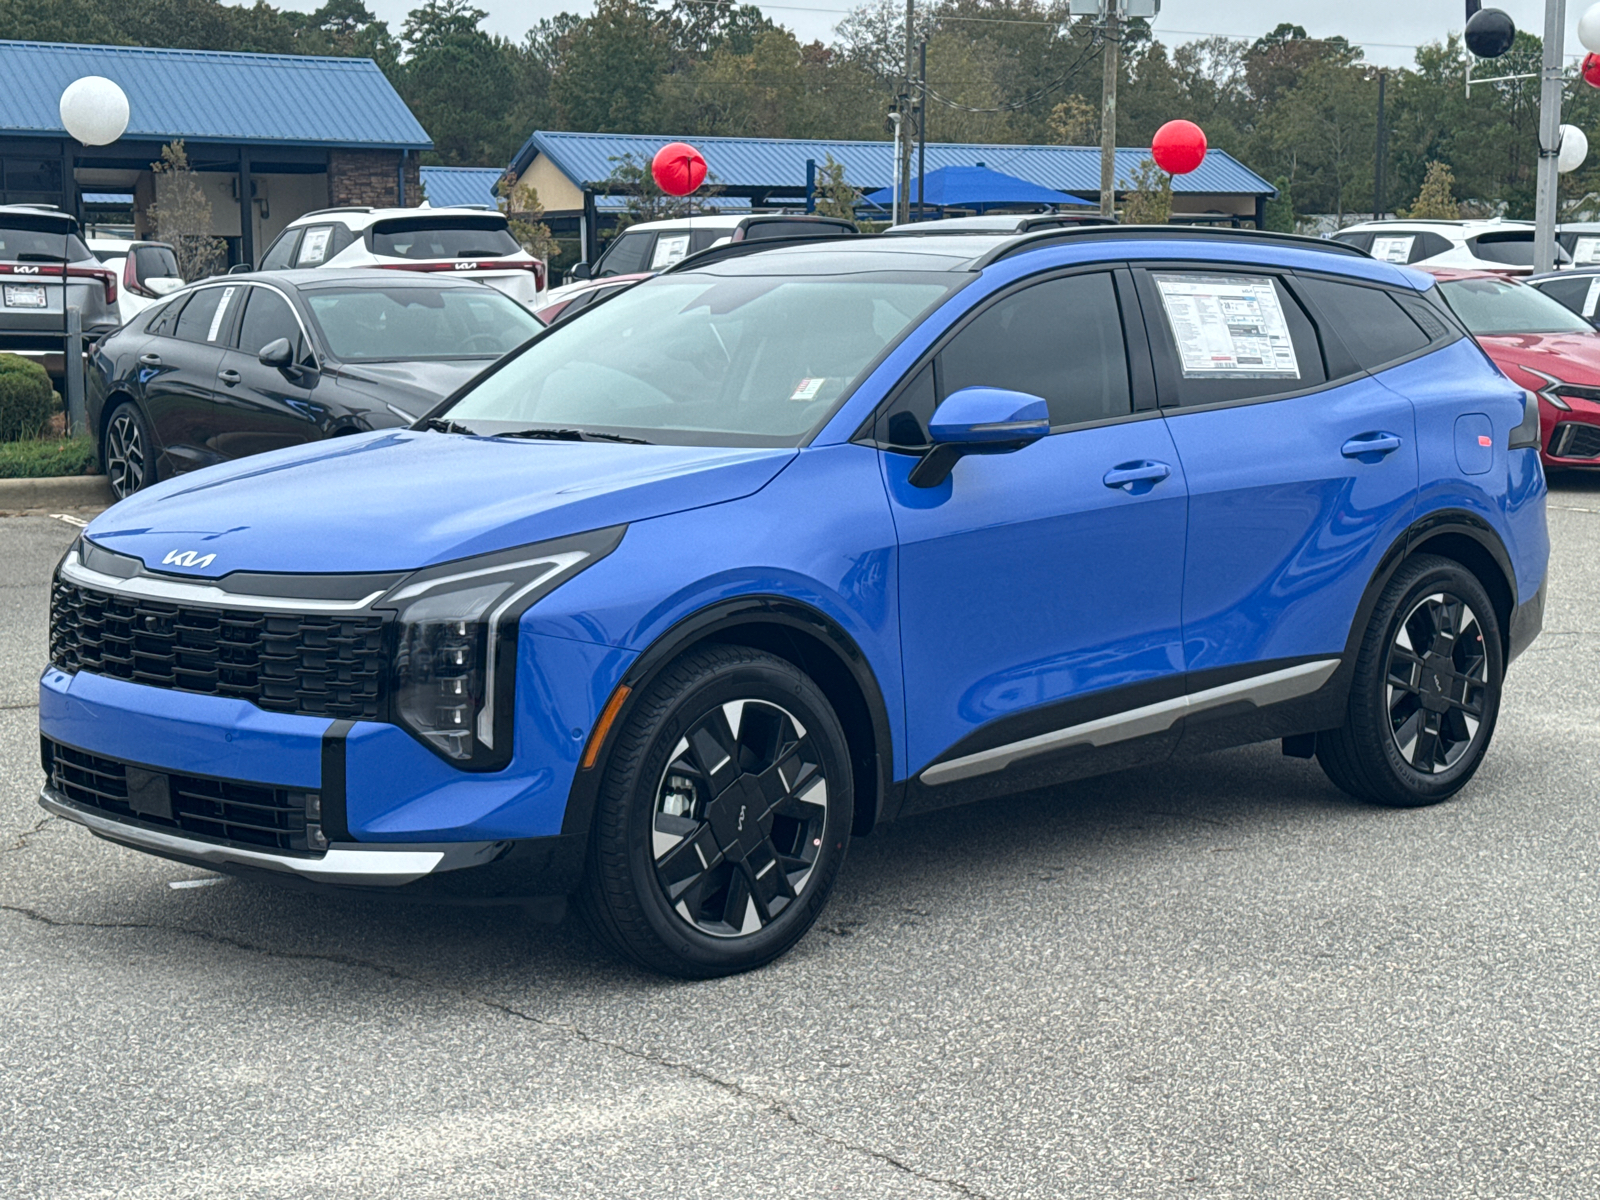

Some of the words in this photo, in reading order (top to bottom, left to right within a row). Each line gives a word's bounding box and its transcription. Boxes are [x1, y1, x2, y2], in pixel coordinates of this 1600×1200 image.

[13, 265, 39, 274] KIA
[454, 262, 477, 270] KIA
[161, 549, 217, 569] KIA
[1386, 742, 1416, 786] MICHELIN
[737, 804, 747, 831] KIA
